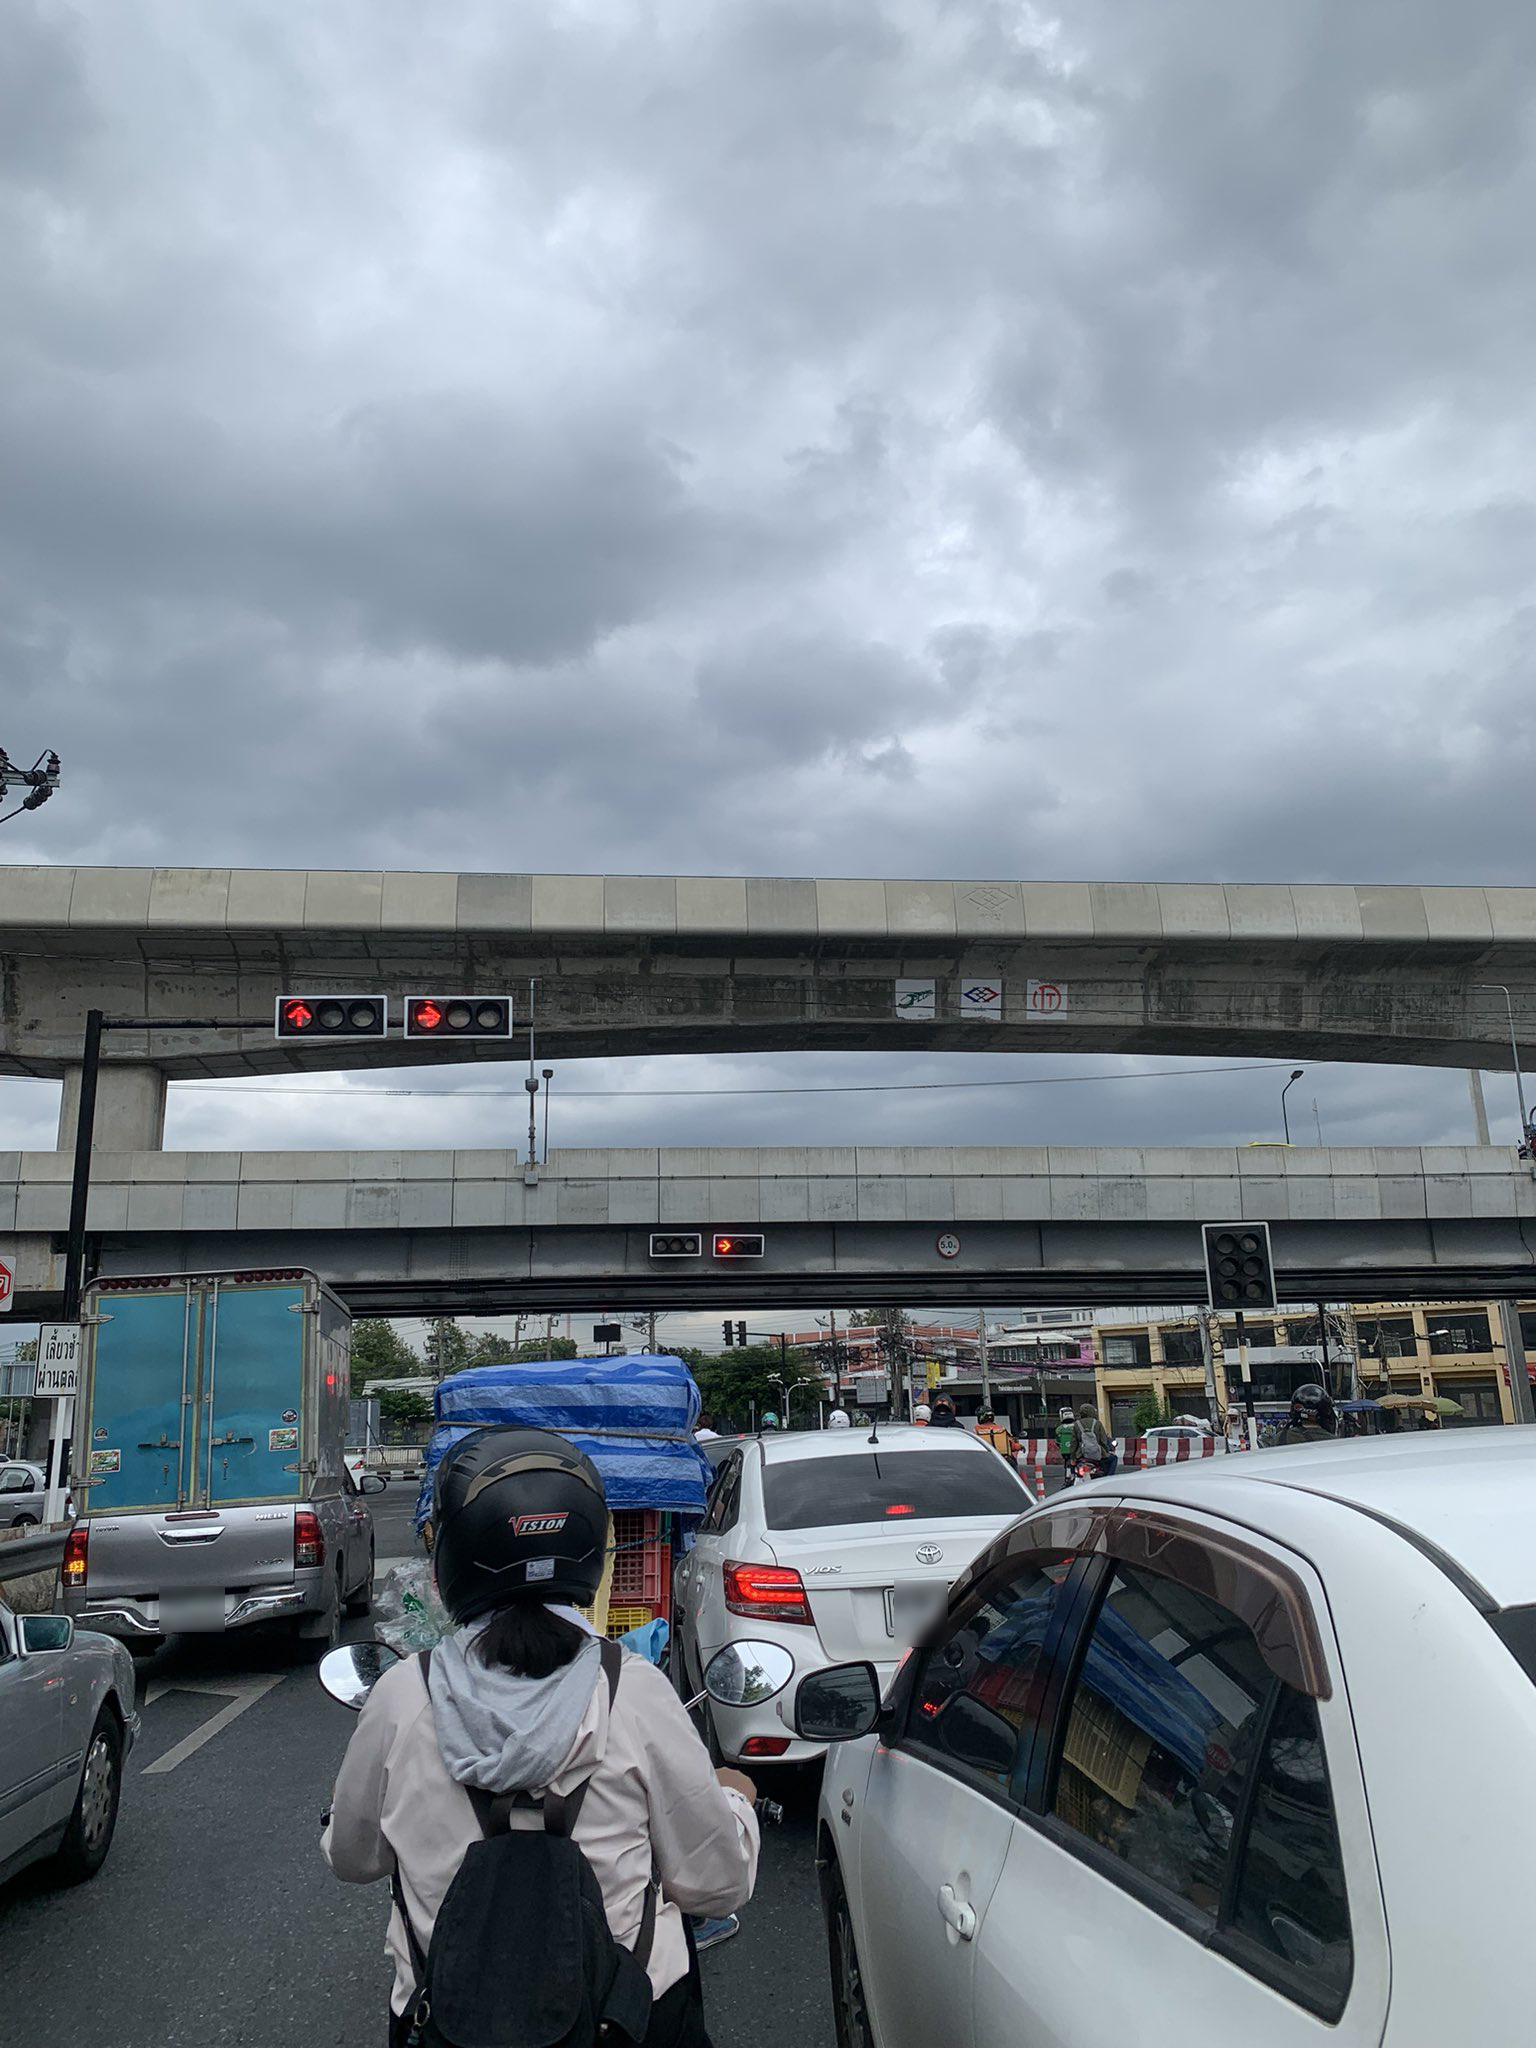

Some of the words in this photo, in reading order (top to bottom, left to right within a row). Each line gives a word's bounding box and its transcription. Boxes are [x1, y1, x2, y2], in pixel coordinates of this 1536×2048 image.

[255, 1511, 289, 1521] HILUX
[508, 1512, 569, 1536] VISION
[803, 1565, 842, 1575] VIOS
